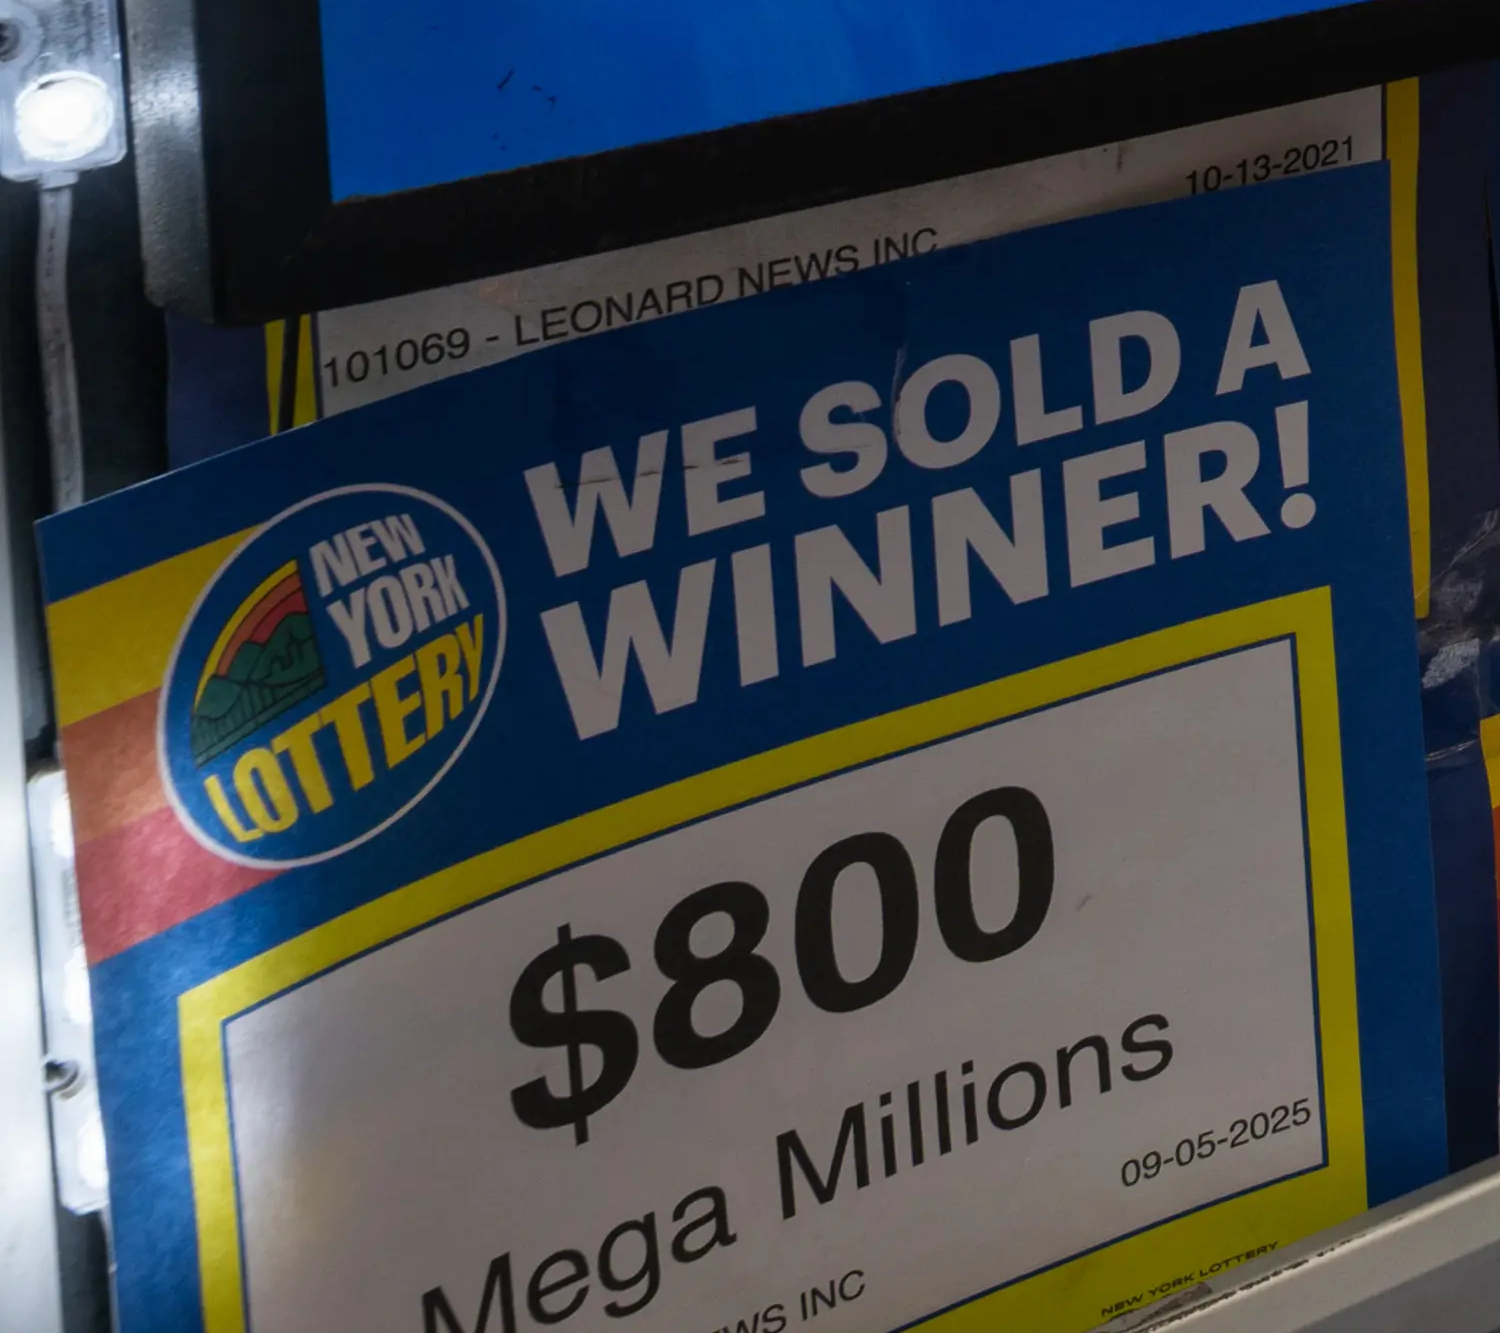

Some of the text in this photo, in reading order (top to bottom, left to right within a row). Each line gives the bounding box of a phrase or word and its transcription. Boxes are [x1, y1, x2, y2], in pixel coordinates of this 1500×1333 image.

[1183, 136, 1358, 197] 10-13-2021
[320, 227, 941, 389] 101069 LEONARD NEWS INC
[523, 279, 1313, 578] WE SOLD A
[308, 511, 422, 600] NEW
[324, 549, 472, 671] YORK
[540, 399, 1318, 741] WINNER!
[203, 614, 488, 843] LOTTERY
[506, 784, 1056, 1146] $800
[418, 1011, 1177, 1333] Mega Millions
[1118, 1096, 1315, 1189] 09-05-2025
[799, 1268, 867, 1321] INC
[1100, 1240, 1280, 1318] NEW YORK LOTTERY
